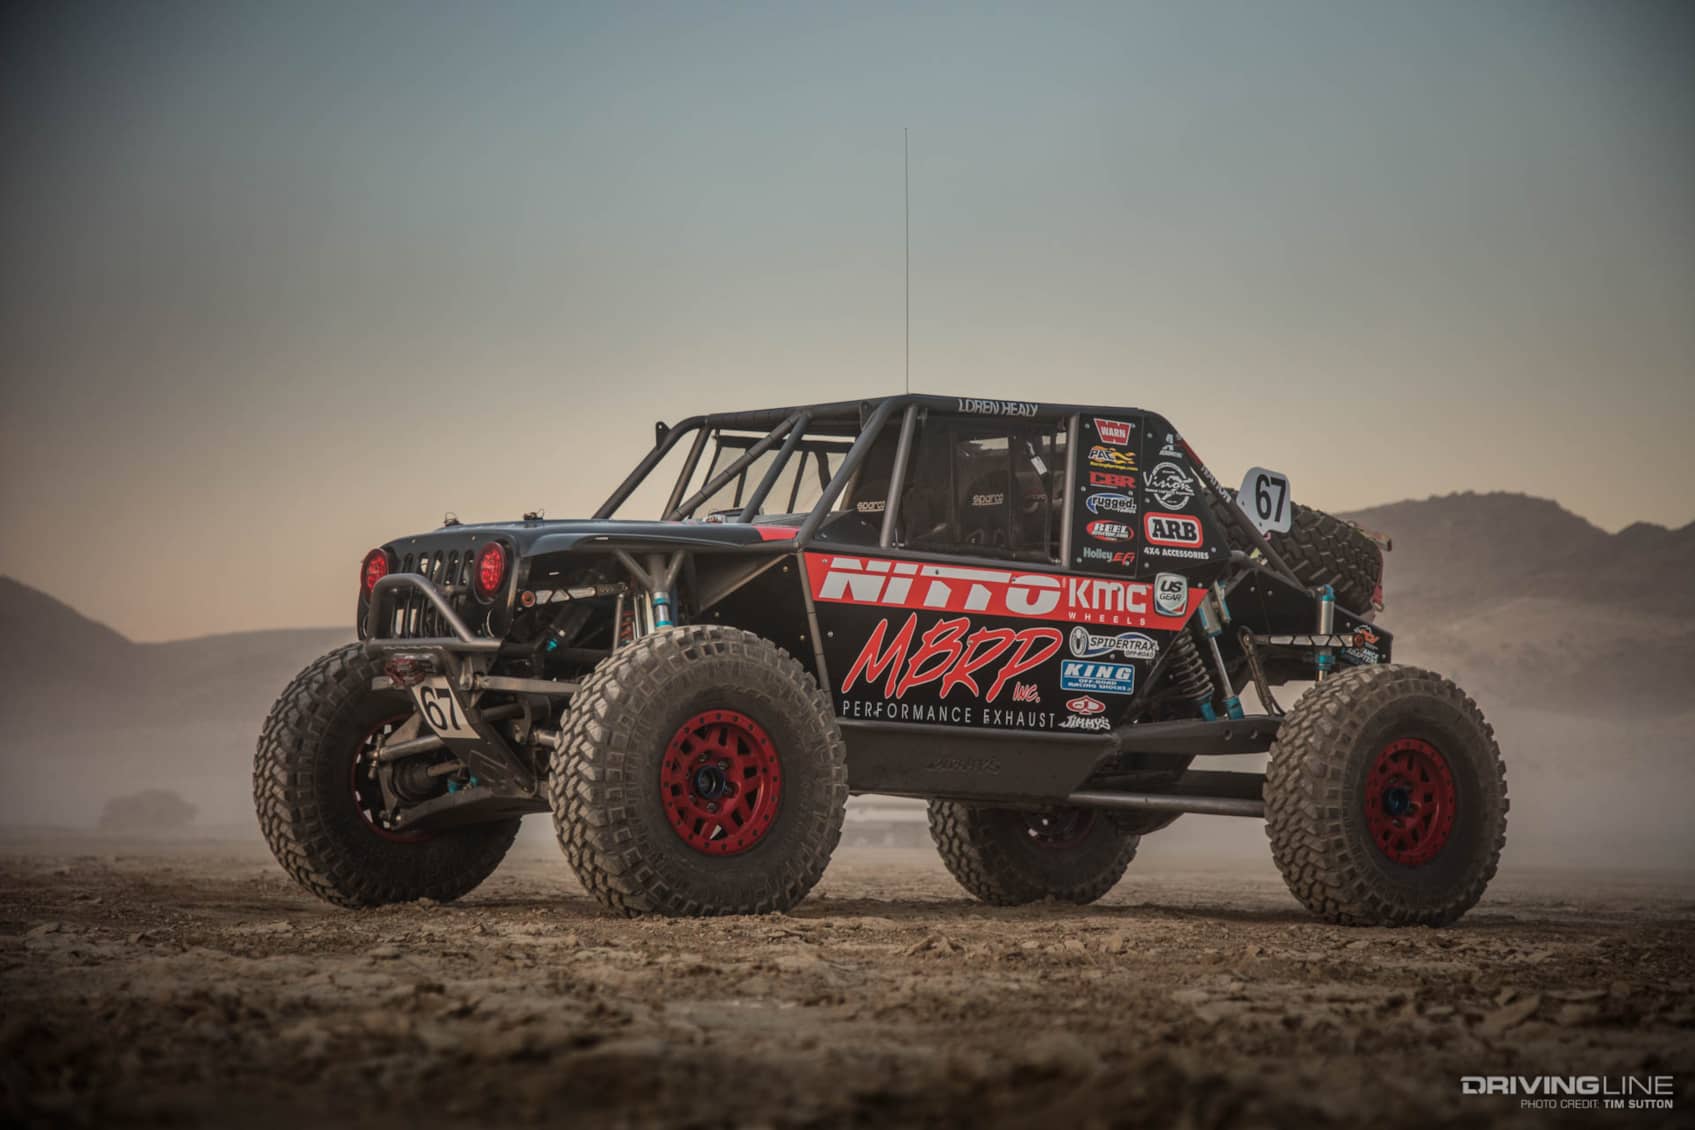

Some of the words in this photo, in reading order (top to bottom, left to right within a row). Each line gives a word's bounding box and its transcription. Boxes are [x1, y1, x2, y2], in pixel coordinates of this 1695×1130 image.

[1001, 401, 1039, 417] HEALY
[1101, 426, 1126, 438] WARN
[1255, 474, 1286, 522] 67
[1152, 519, 1197, 541] ARB
[1083, 546, 1113, 562] Holley
[1162, 549, 1209, 560] ACCESSORIES
[1161, 580, 1183, 593] US
[1159, 593, 1183, 602] GEAR
[1068, 611, 1146, 626] WHEELS
[841, 611, 1064, 703] MBRP
[1064, 663, 1132, 681] KING
[420, 686, 462, 731] 67
[842, 700, 972, 723] PERFORMANCE
[983, 708, 1056, 729] EXHAUST
